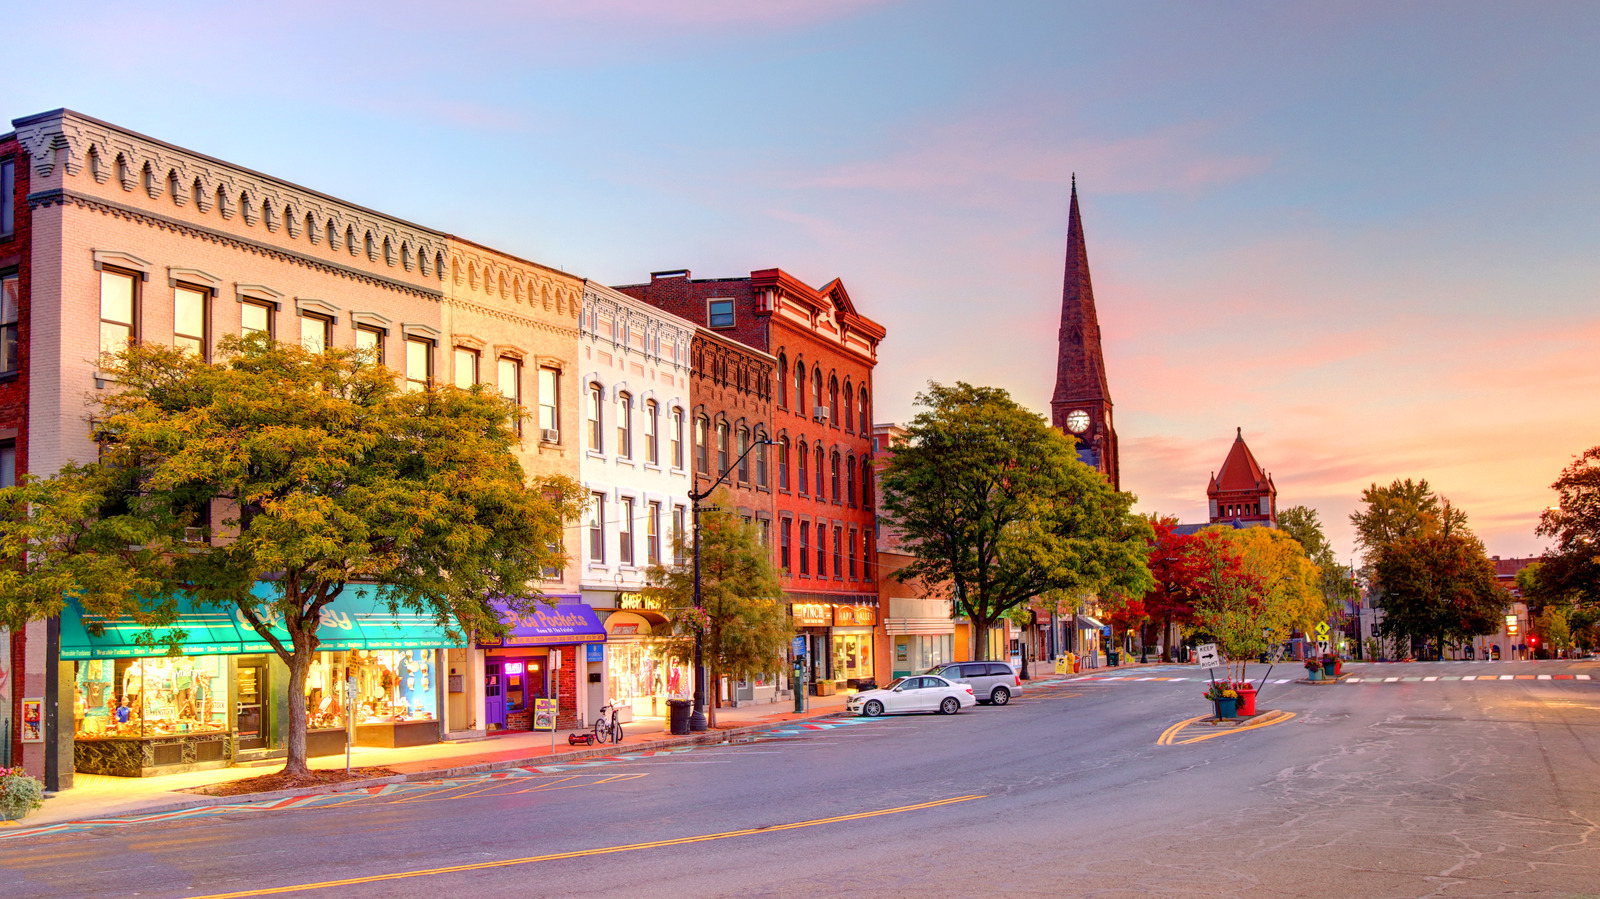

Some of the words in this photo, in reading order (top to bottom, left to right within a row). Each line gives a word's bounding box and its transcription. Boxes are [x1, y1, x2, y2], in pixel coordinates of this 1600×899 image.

[621, 592, 642, 609] SHOP
[803, 607, 823, 618] PINCH
[856, 611, 873, 620] VALLEY
[505, 610, 539, 628] Pita
[535, 610, 588, 627] Pockets
[1201, 660, 1218, 668] RIGHT
